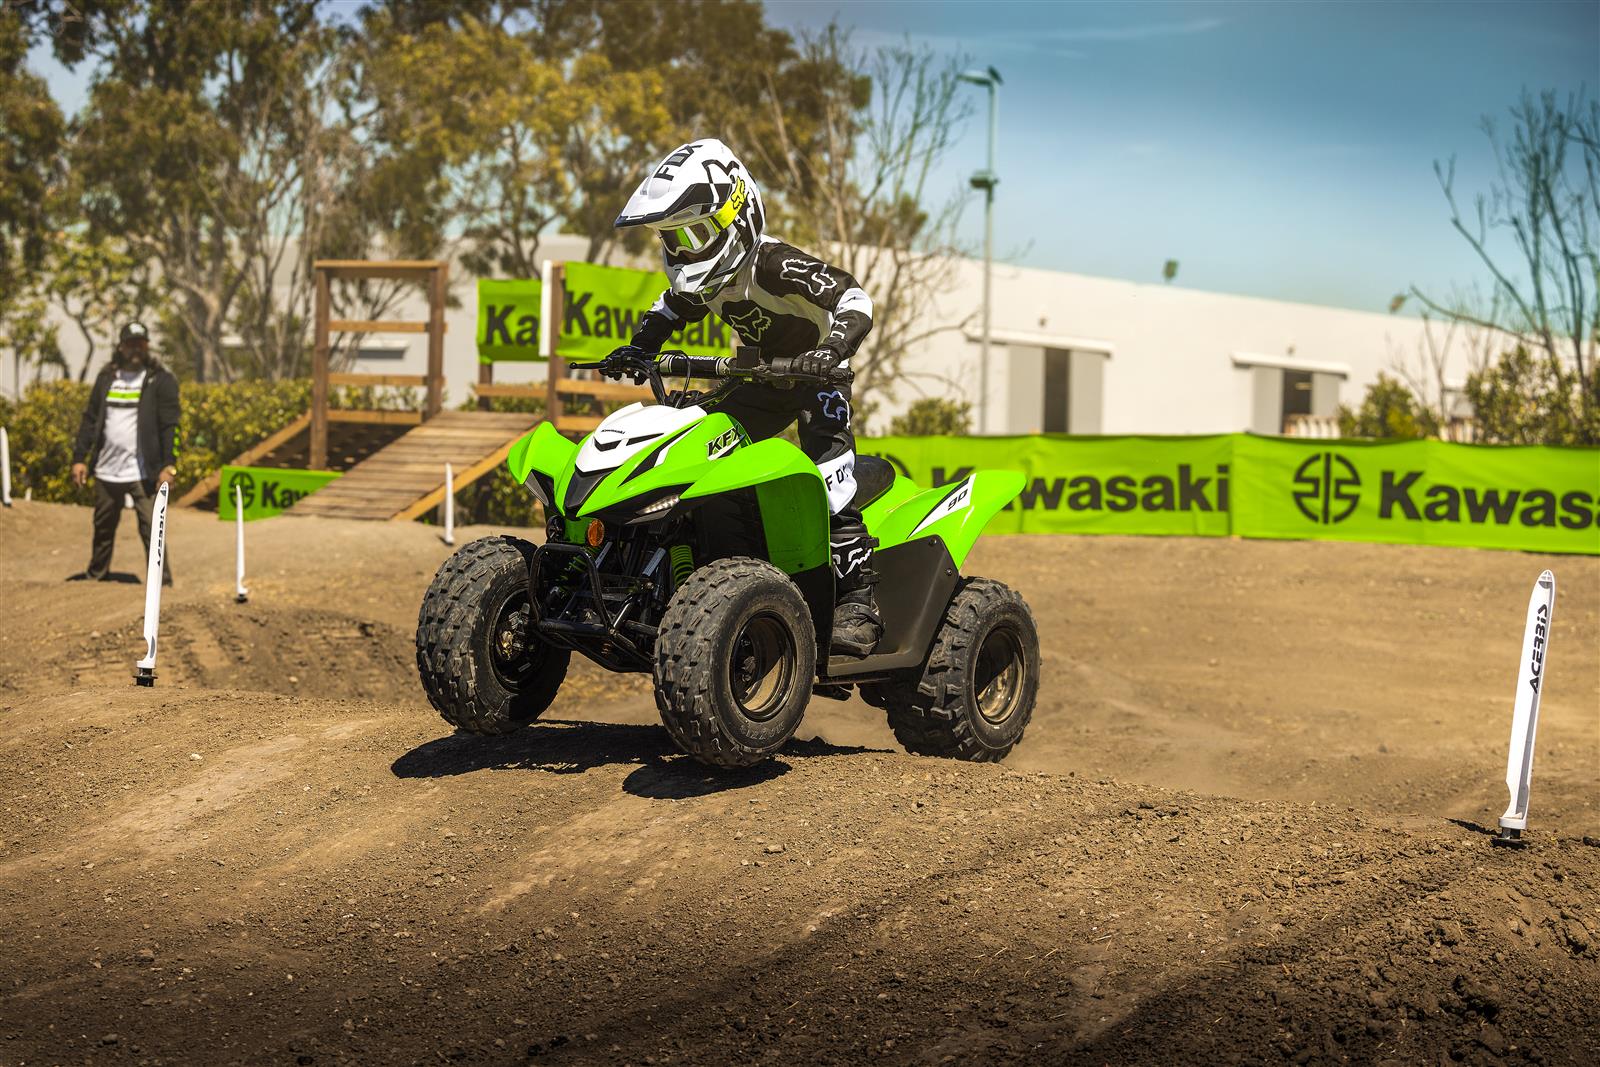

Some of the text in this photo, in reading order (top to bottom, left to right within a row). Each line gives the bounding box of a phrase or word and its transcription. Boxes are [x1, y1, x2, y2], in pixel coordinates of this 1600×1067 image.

[708, 425, 742, 456] KFX
[931, 465, 1229, 512] wasaki
[947, 487, 969, 511] 90
[1379, 470, 1600, 530] Kawas
